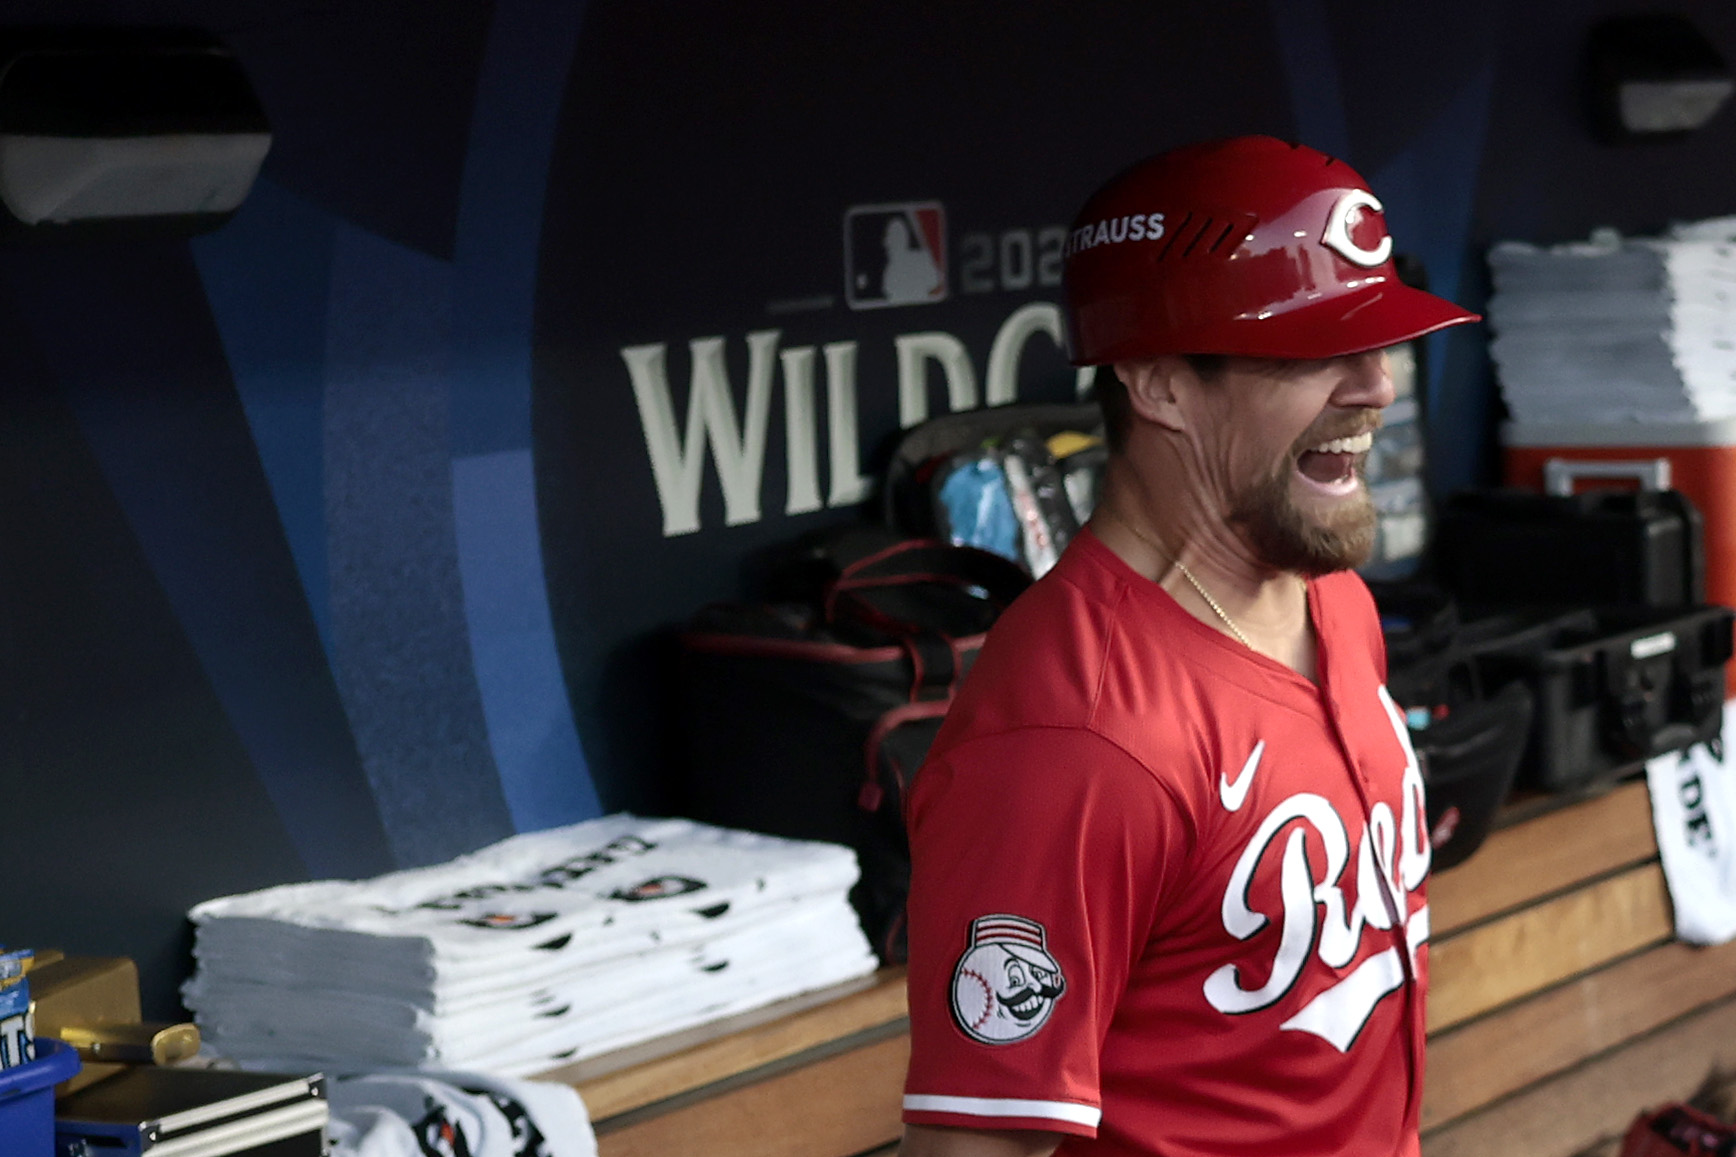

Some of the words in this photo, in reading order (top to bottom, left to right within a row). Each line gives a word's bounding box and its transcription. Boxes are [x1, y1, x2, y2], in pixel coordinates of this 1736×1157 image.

[961, 226, 1068, 294] 202
[1066, 212, 1165, 259] TRAUSS
[1323, 189, 1393, 267] C
[1203, 685, 1432, 1018] Red
